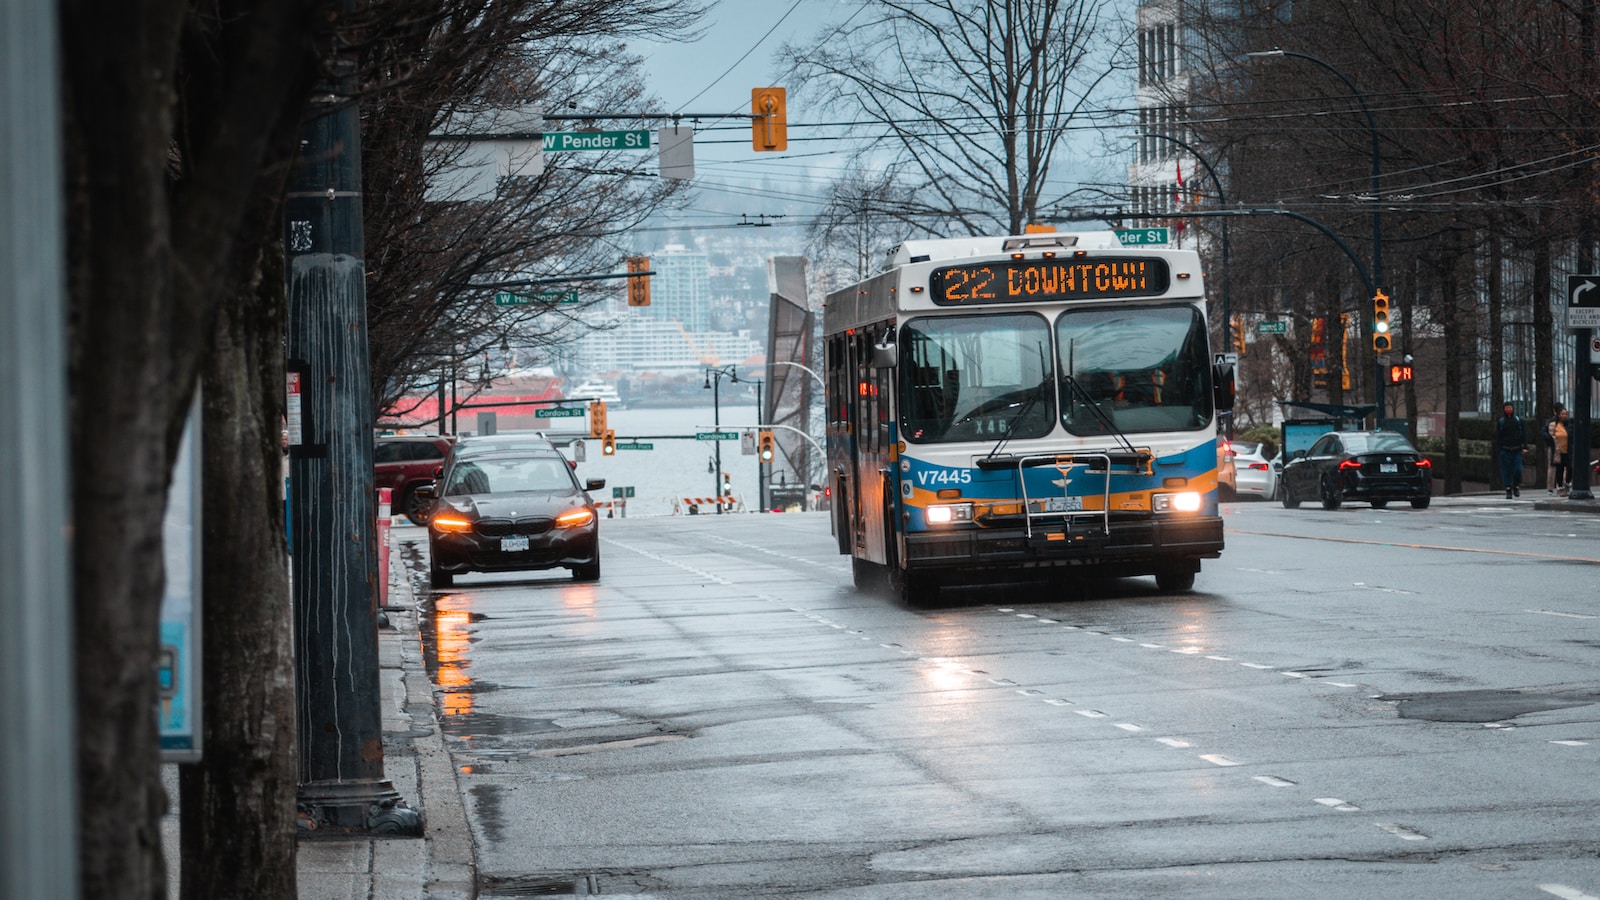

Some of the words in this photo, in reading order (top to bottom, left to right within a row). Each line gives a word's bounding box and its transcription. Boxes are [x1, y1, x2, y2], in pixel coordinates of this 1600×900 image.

[542, 135, 556, 149] W
[562, 134, 618, 148] Pender
[624, 133, 643, 147] St
[1117, 231, 1142, 243] der
[1147, 231, 1162, 243] St
[944, 267, 996, 301] 22
[1007, 261, 1146, 296] DOWNTOWN
[500, 294, 511, 303] W
[514, 293, 558, 304] Haings
[563, 292, 574, 302] St
[538, 409, 570, 418] Cordova
[572, 409, 581, 417] St
[728, 432, 736, 440] St
[917, 469, 972, 485] V7445
